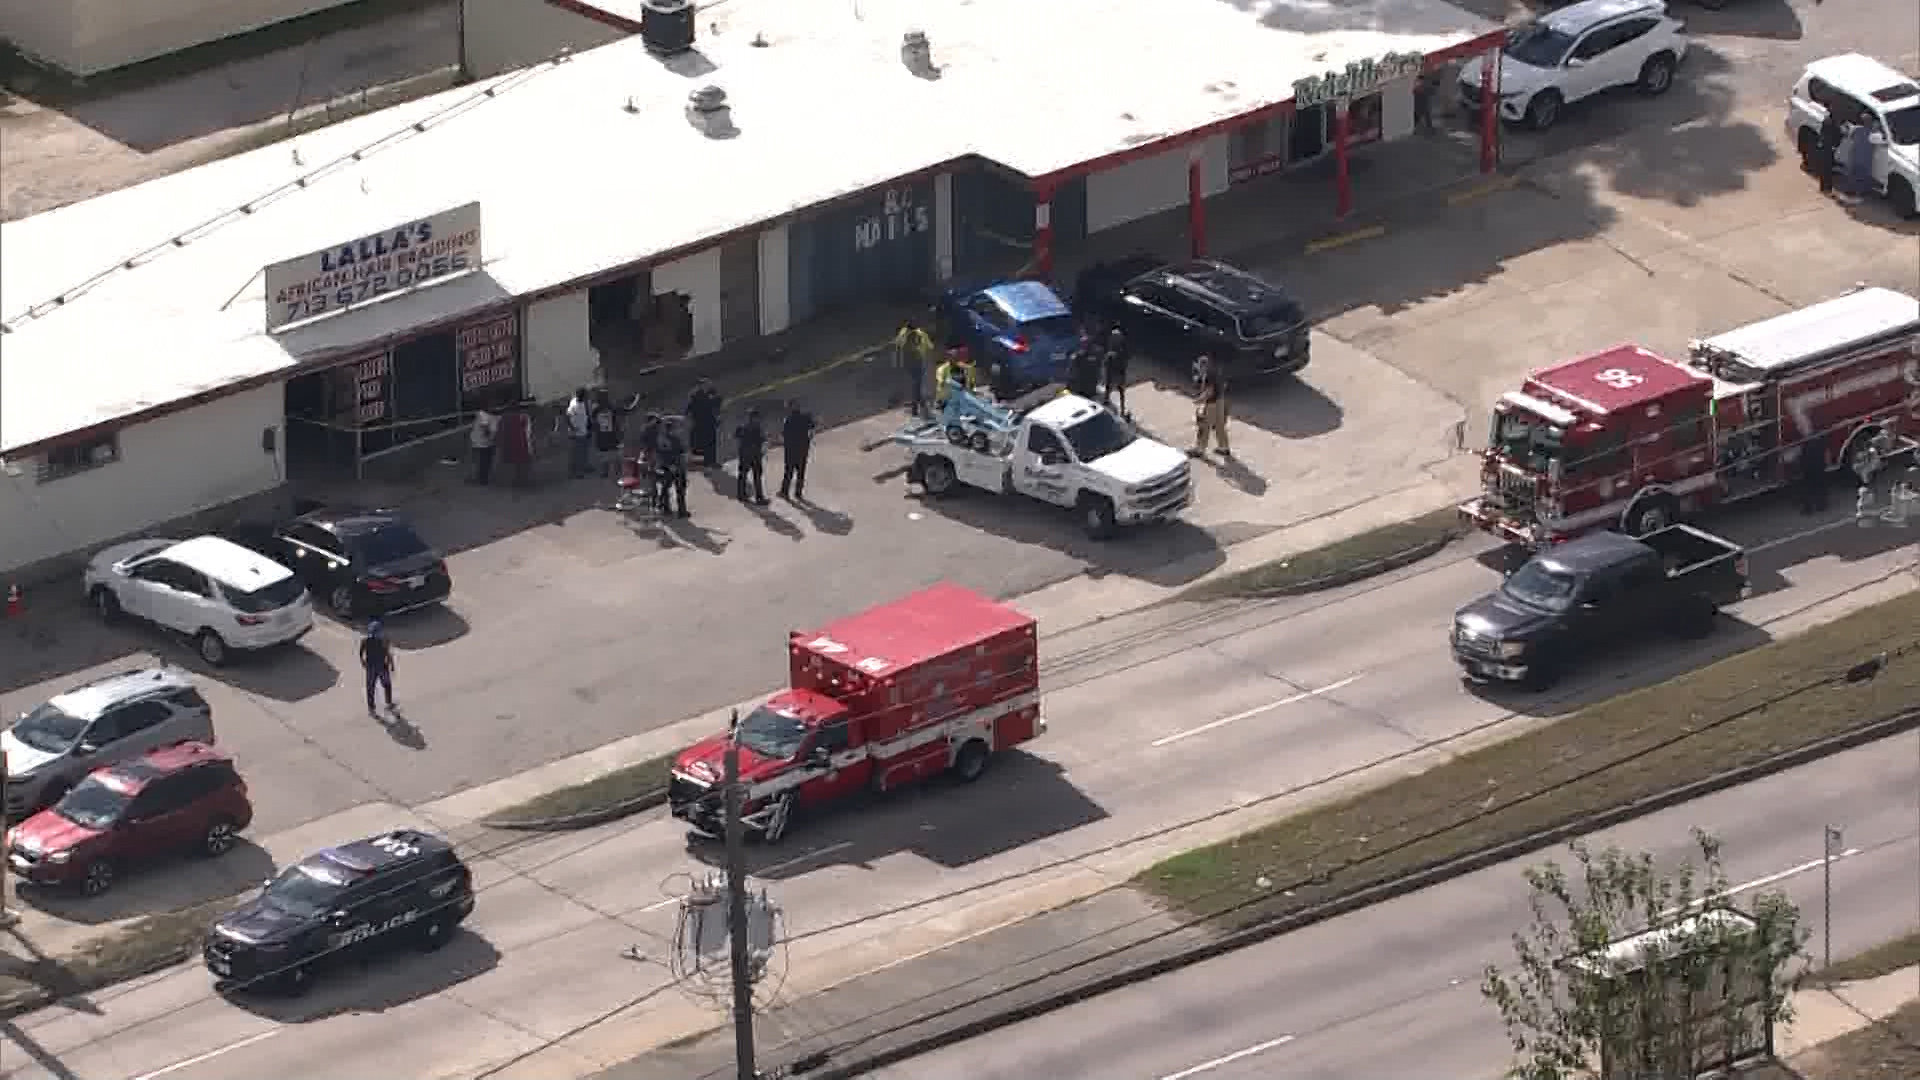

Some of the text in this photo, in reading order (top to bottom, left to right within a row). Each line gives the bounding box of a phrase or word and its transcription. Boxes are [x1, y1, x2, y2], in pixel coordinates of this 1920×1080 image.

[321, 221, 433, 272] LALLA'S
[277, 269, 352, 304] AFRICAN
[287, 294, 328, 321] 713
[341, 906, 418, 946] POLICE
